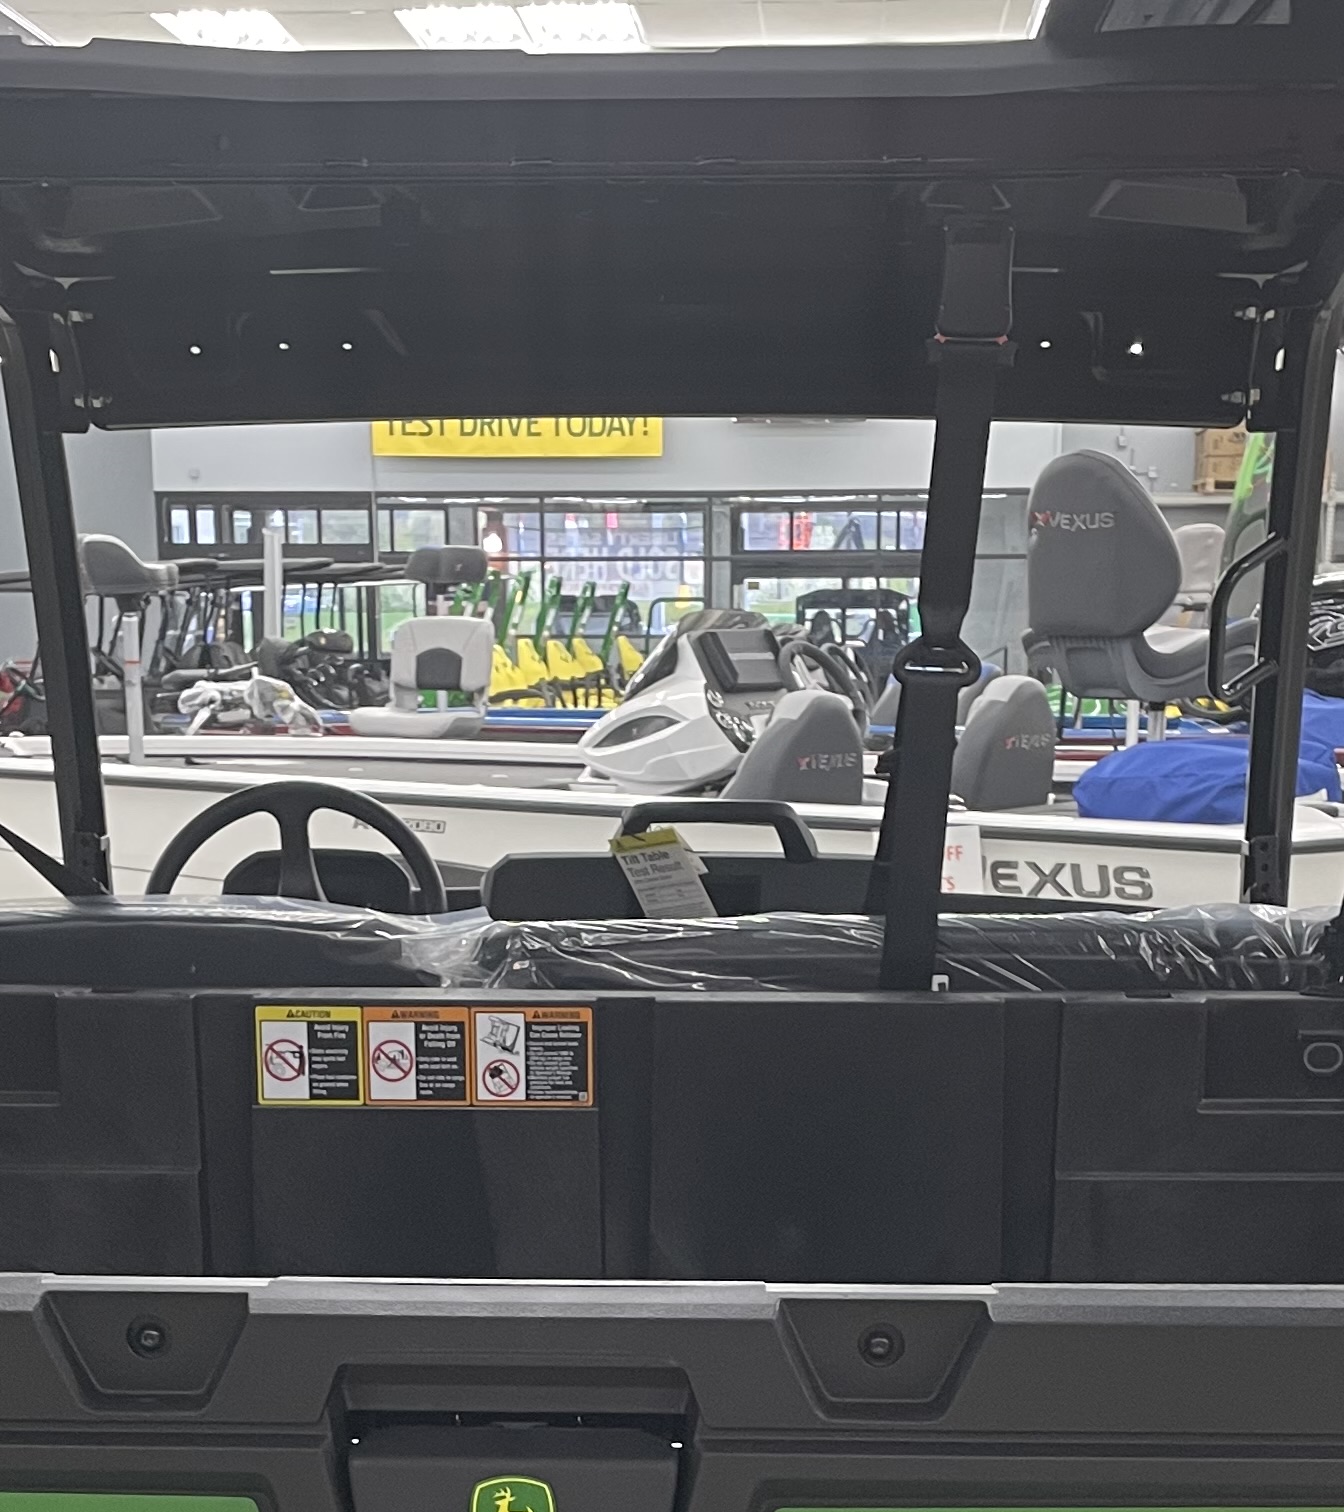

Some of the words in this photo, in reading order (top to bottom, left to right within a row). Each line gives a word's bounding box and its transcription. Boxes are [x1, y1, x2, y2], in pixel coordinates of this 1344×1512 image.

[460, 418, 542, 437] DRIVE
[553, 417, 650, 437] TODAY!
[1049, 511, 1115, 531] VEXUS
[982, 855, 1154, 900] EXUS
[296, 1010, 331, 1018] CAUTION
